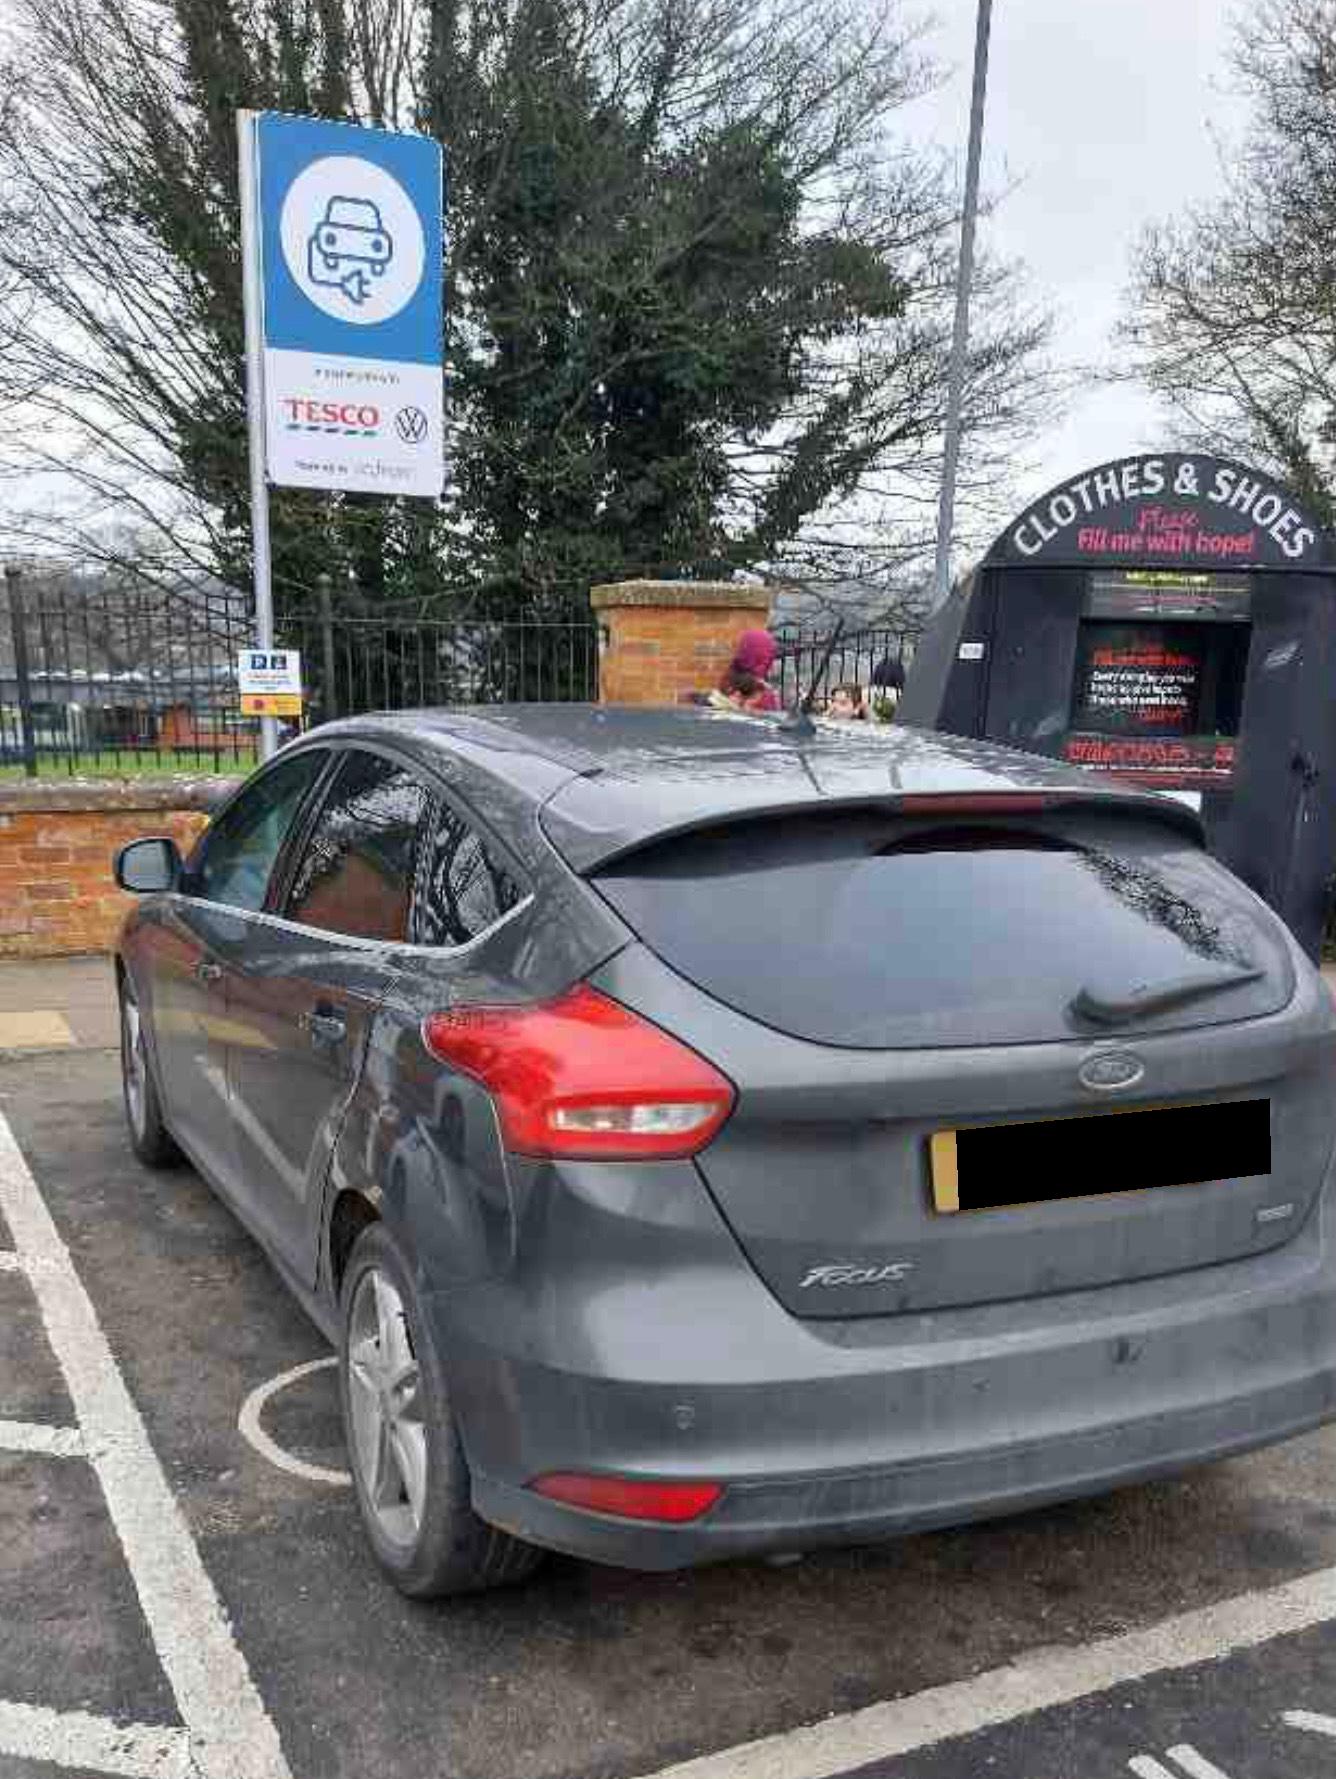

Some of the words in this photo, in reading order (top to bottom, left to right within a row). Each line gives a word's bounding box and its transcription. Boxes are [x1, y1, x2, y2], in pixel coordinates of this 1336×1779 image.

[283, 398, 380, 427] TESCO
[1012, 459, 1165, 555] CLOTHES
[1173, 462, 1199, 496] &
[1208, 468, 1314, 557] SHOES
